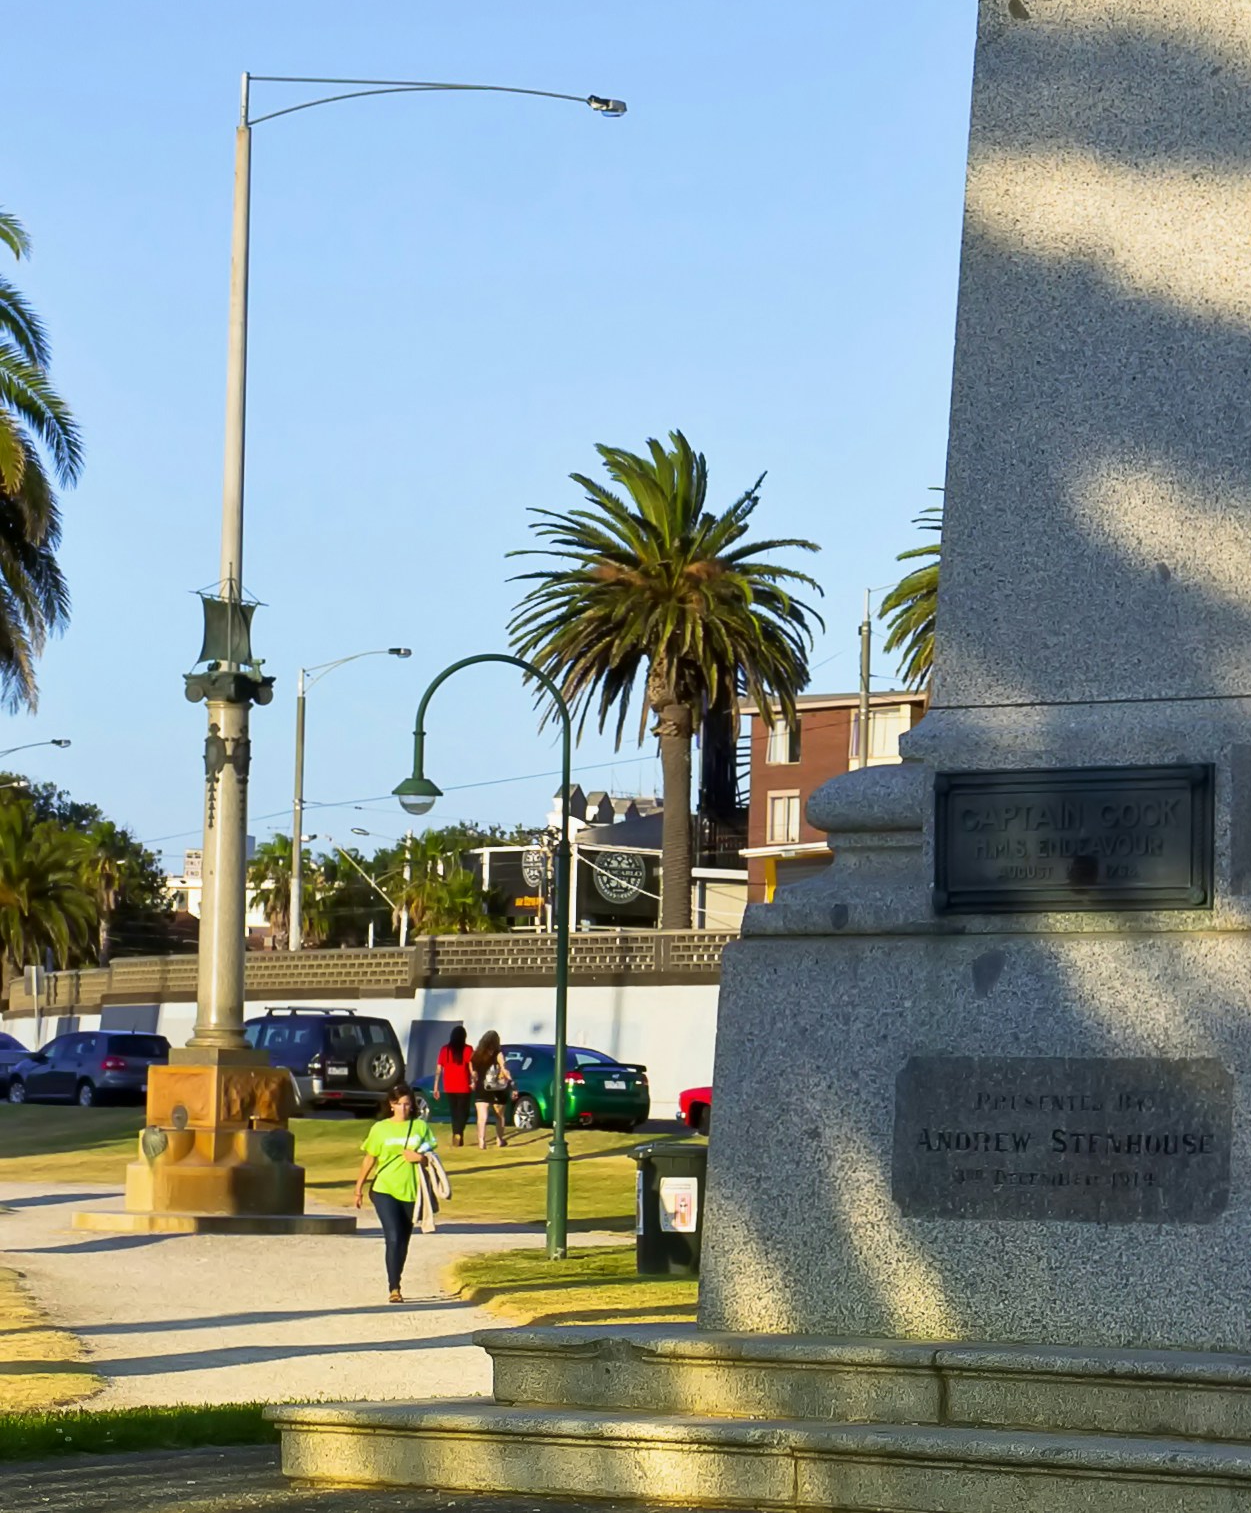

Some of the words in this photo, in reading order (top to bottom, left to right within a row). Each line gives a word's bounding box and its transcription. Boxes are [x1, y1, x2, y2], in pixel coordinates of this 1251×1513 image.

[961, 800, 1084, 832] CAPTAIN
[1100, 798, 1182, 829] COOK
[1037, 834, 1164, 859] ENDEAVOUR
[998, 864, 1054, 880] AUGUST
[916, 1127, 1031, 1155] ANDREW
[1051, 1128, 1215, 1156] STENHOUSE
